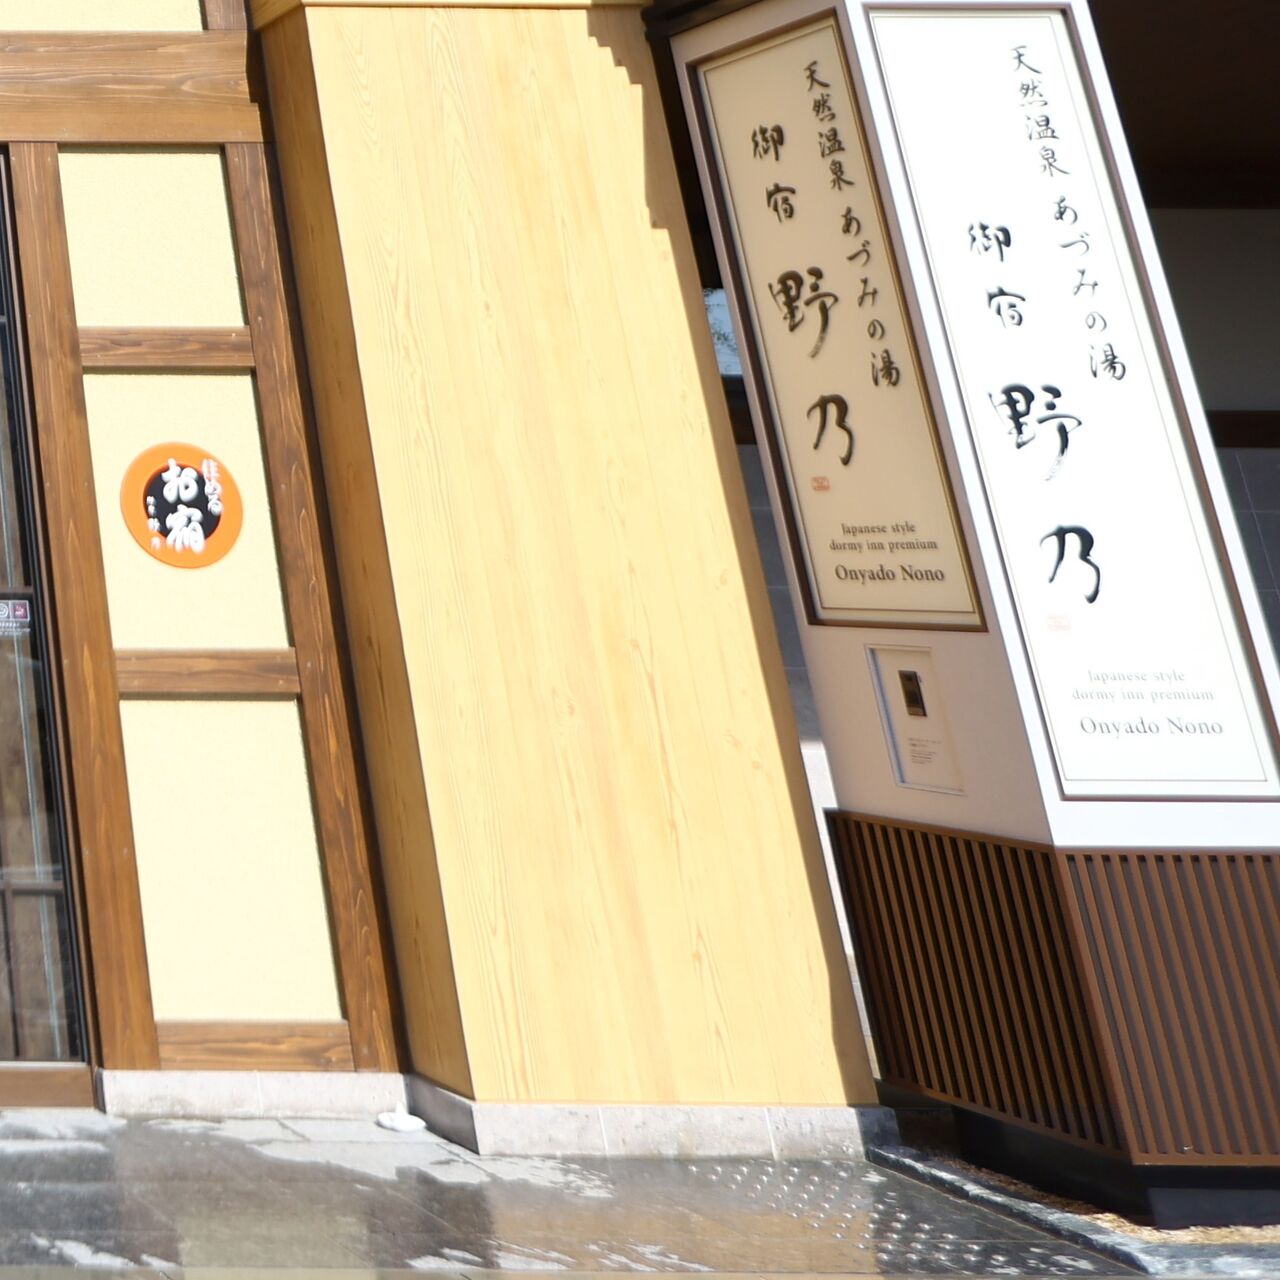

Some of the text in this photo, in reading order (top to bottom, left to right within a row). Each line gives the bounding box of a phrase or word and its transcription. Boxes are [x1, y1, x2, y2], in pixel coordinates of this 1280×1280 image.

[803, 59, 901, 388] 天然温泉 あづみの湯
[1009, 45, 1127, 383] 天然温泉 あづみの湯
[751, 123, 854, 467] 御宿 野乃
[968, 221, 1101, 605] 御宿 野乃
[841, 521, 916, 537] Japanese style
[829, 539, 938, 553] dormy inn premium
[834, 564, 945, 585] Onyado Nono
[1087, 669, 1186, 684] Japanese style
[1071, 688, 1214, 703] dormy inn premium
[1080, 716, 1224, 739] Onyado Nono
